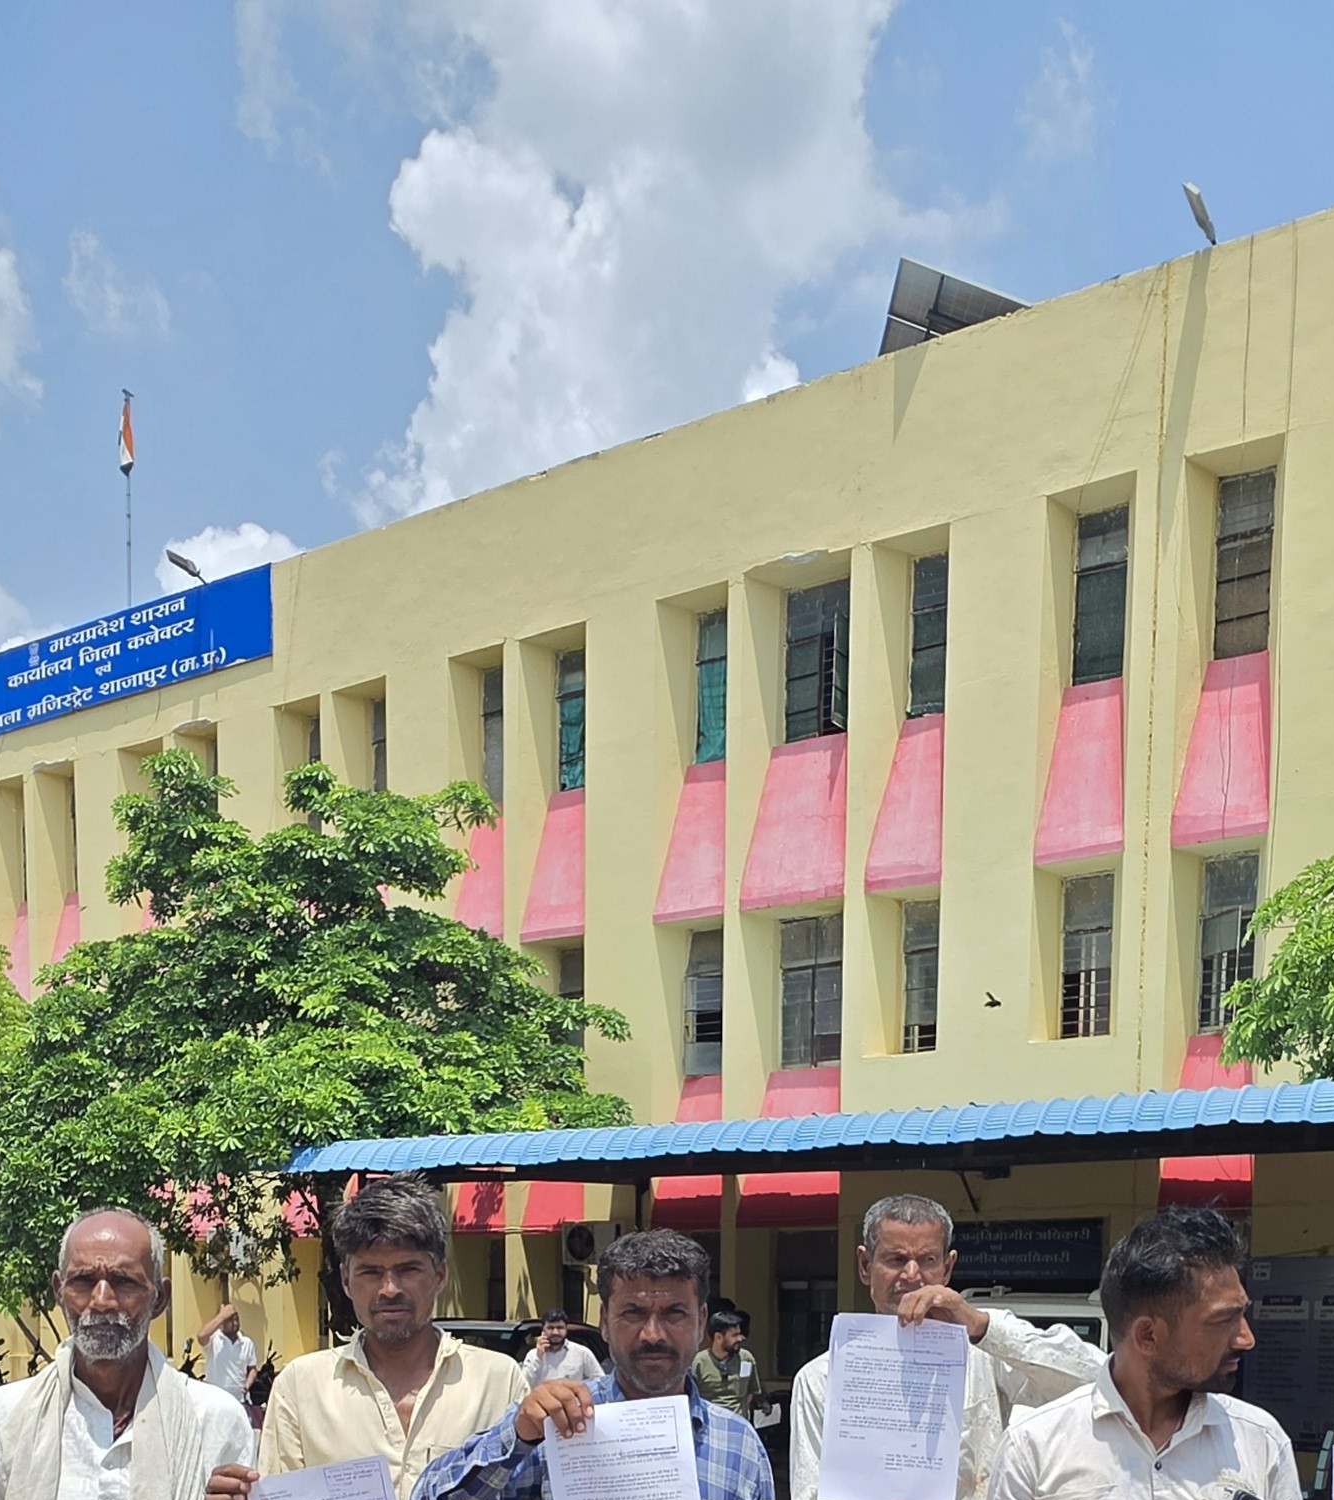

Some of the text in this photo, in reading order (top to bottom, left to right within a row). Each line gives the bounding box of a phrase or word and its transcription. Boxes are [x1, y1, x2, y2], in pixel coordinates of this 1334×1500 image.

[49, 596, 187, 654] मध्यप्रदेश शासन
[7, 657, 73, 688] कार्यालय
[79, 641, 121, 667] जिला
[95, 661, 112, 676] एवं
[99, 664, 167, 696] शाजापुर
